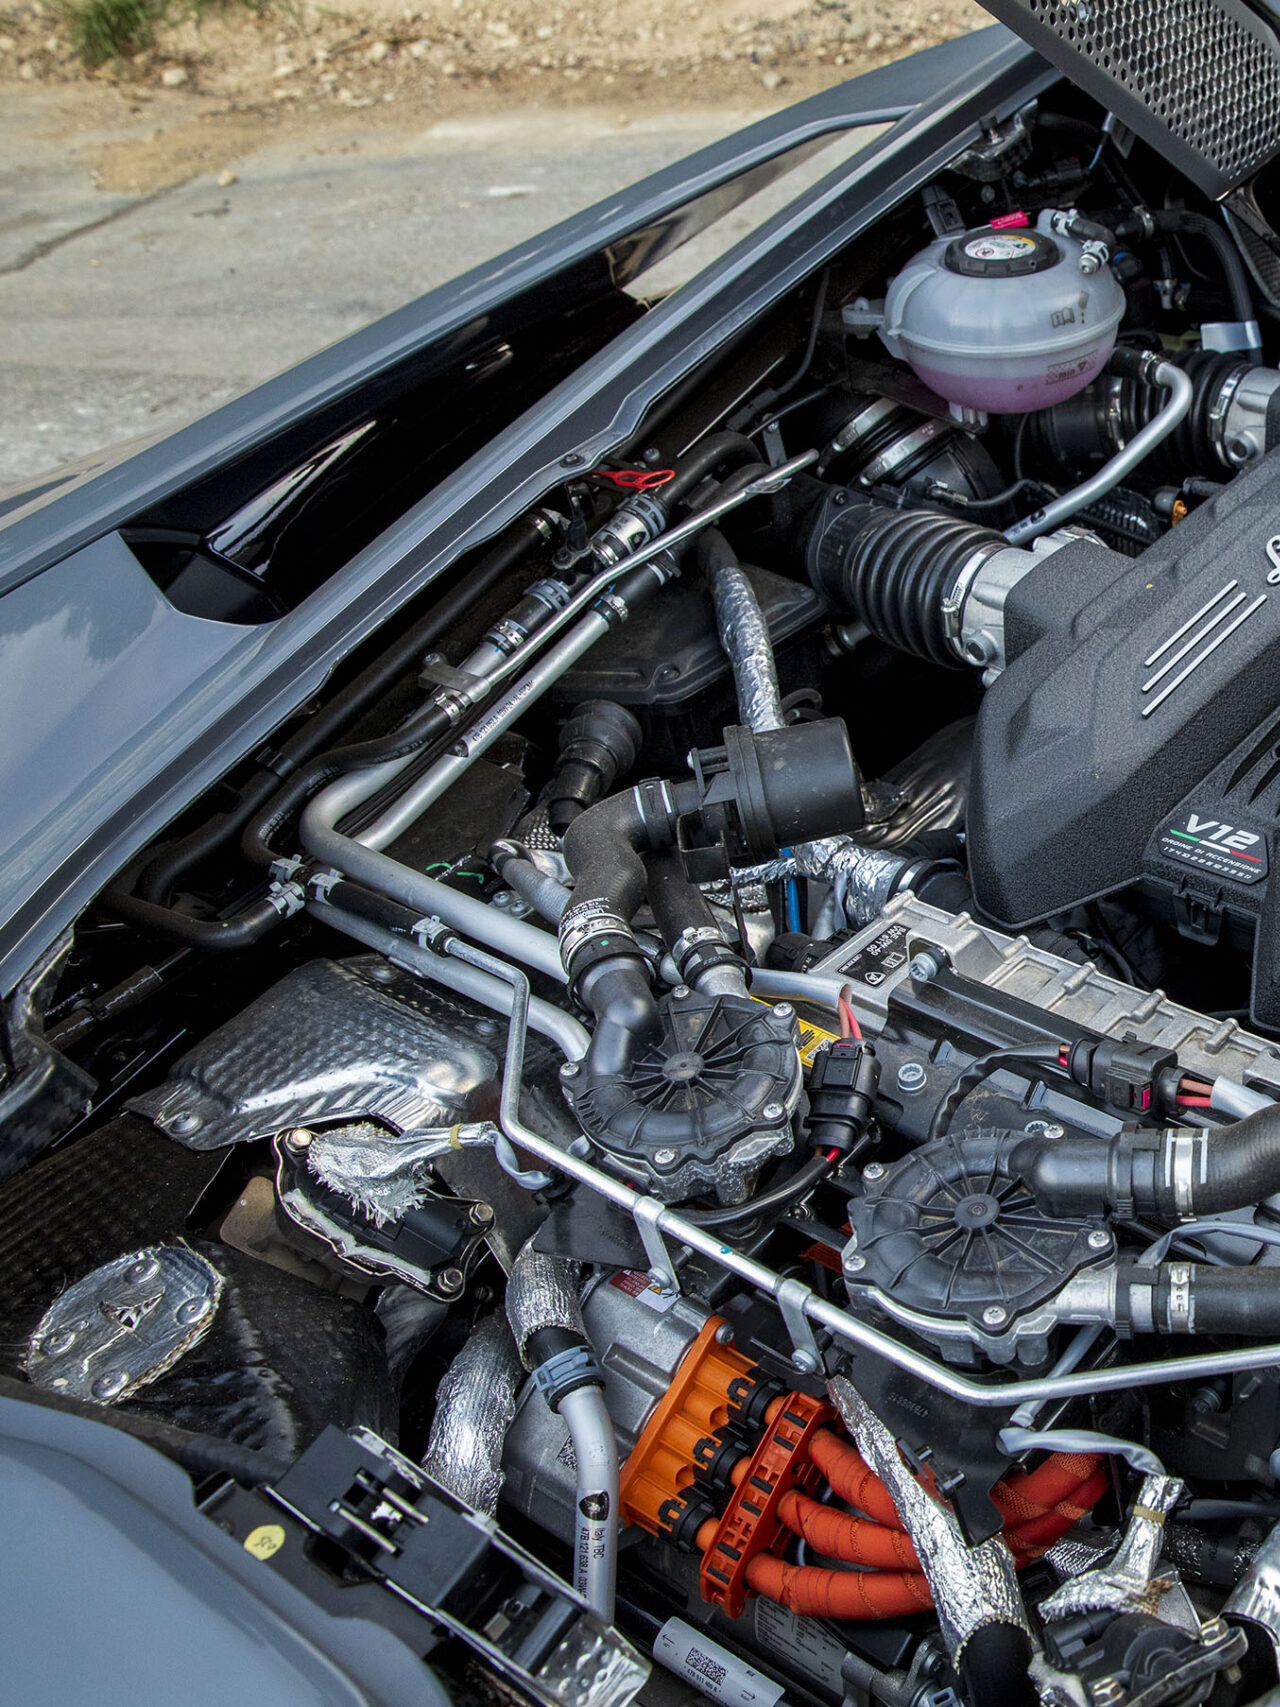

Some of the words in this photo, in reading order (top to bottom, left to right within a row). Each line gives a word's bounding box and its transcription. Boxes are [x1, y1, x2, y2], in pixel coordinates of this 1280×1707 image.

[1186, 814, 1260, 850] V12
[1161, 837, 1193, 850] ORDINE
[1205, 851, 1261, 874] ACCENSIONE
[592, 1527, 605, 1540] Italy
[593, 1543, 604, 1558] TBC
